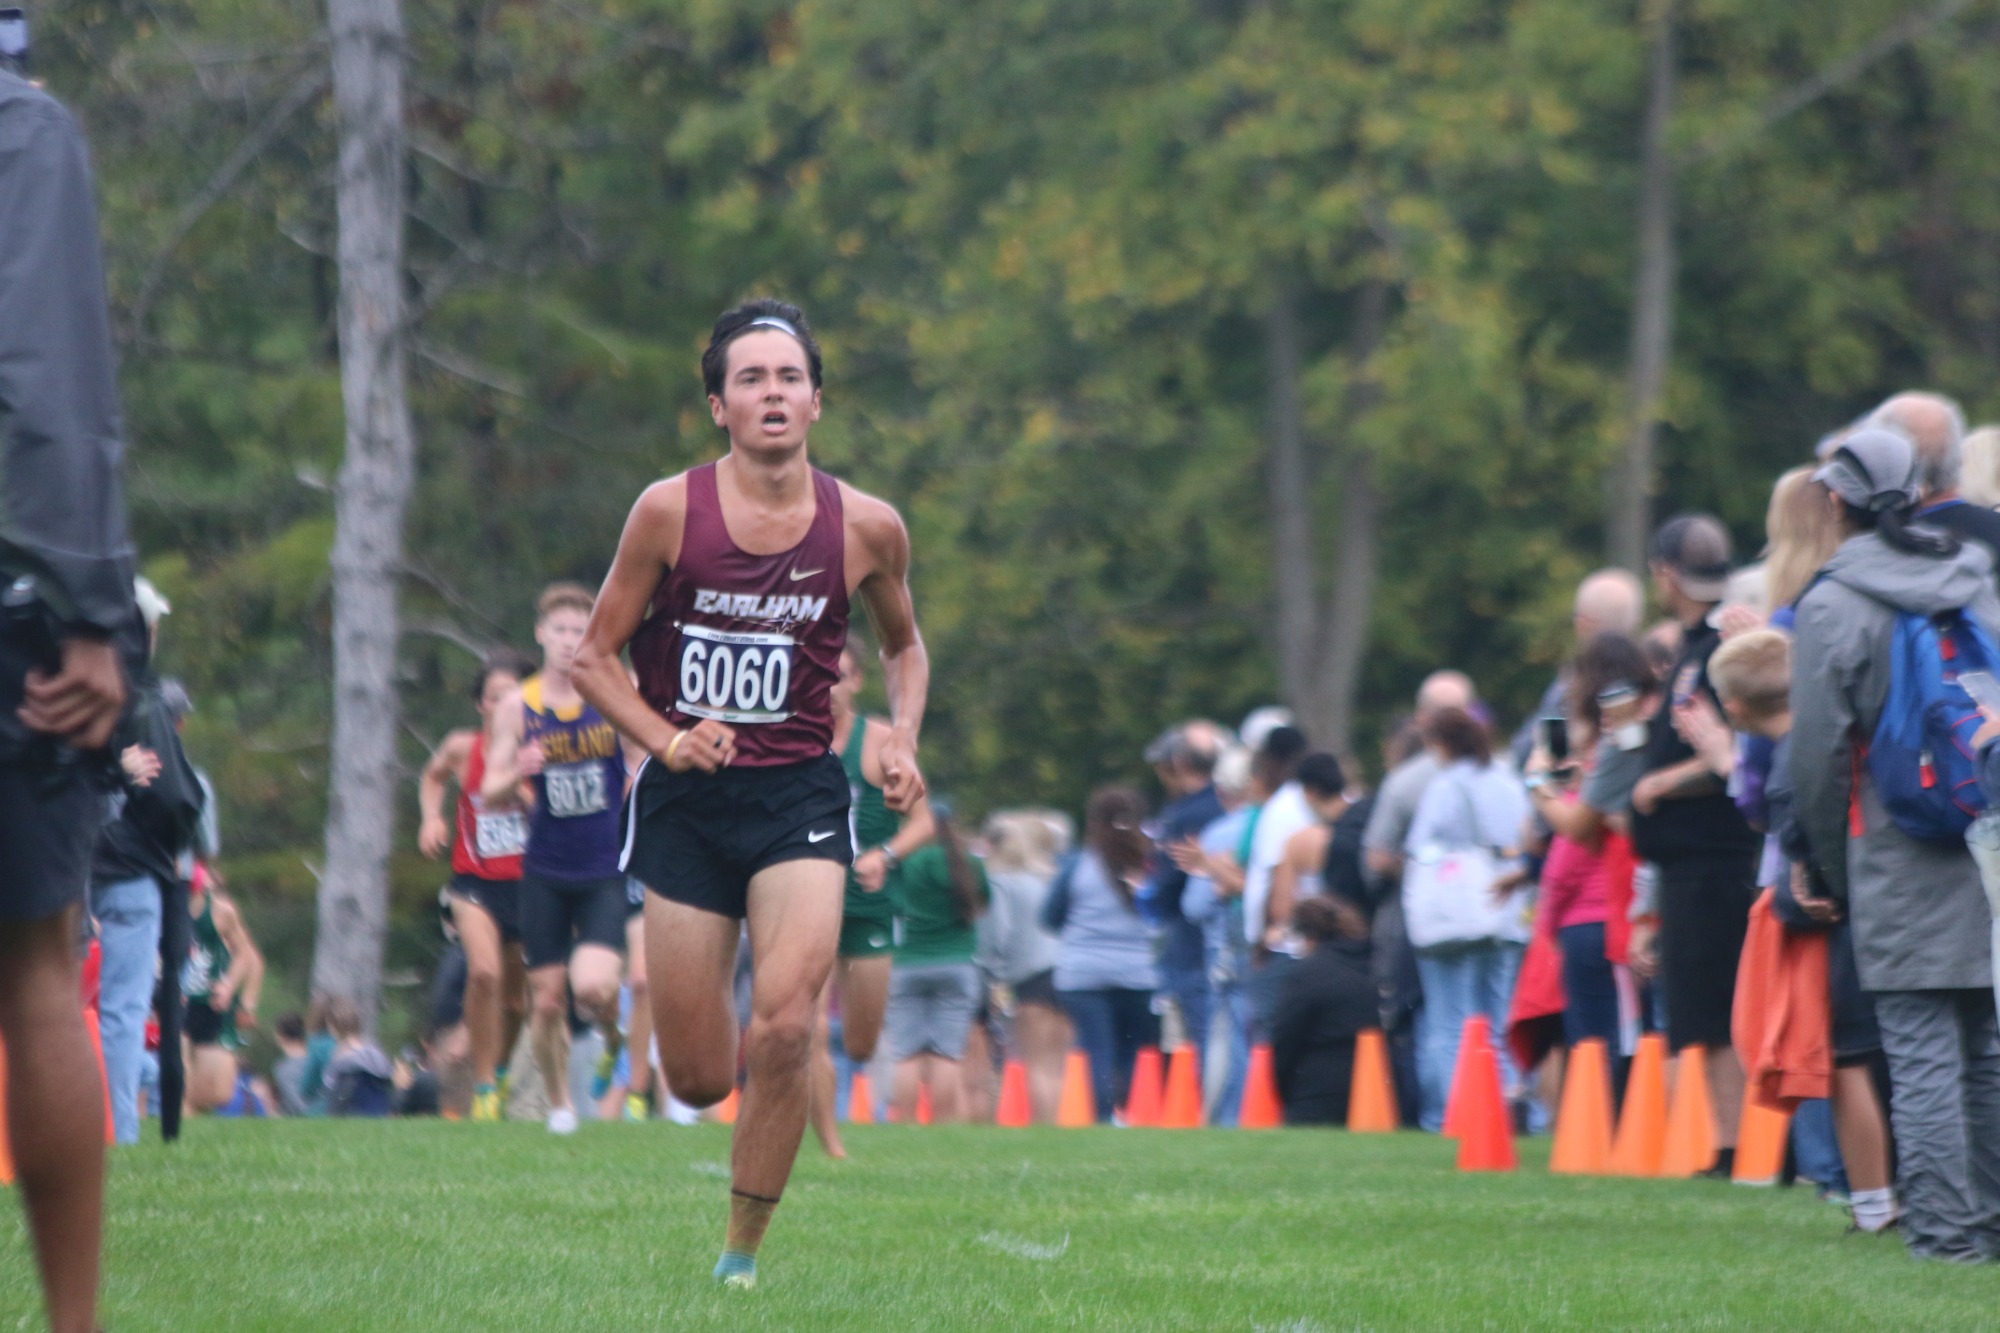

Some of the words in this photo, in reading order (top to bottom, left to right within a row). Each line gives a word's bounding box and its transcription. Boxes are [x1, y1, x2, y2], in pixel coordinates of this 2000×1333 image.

[693, 589, 829, 622] EARLHAM
[680, 640, 789, 712] 6060
[540, 722, 616, 762] SHLAND
[547, 772, 606, 812] 6012
